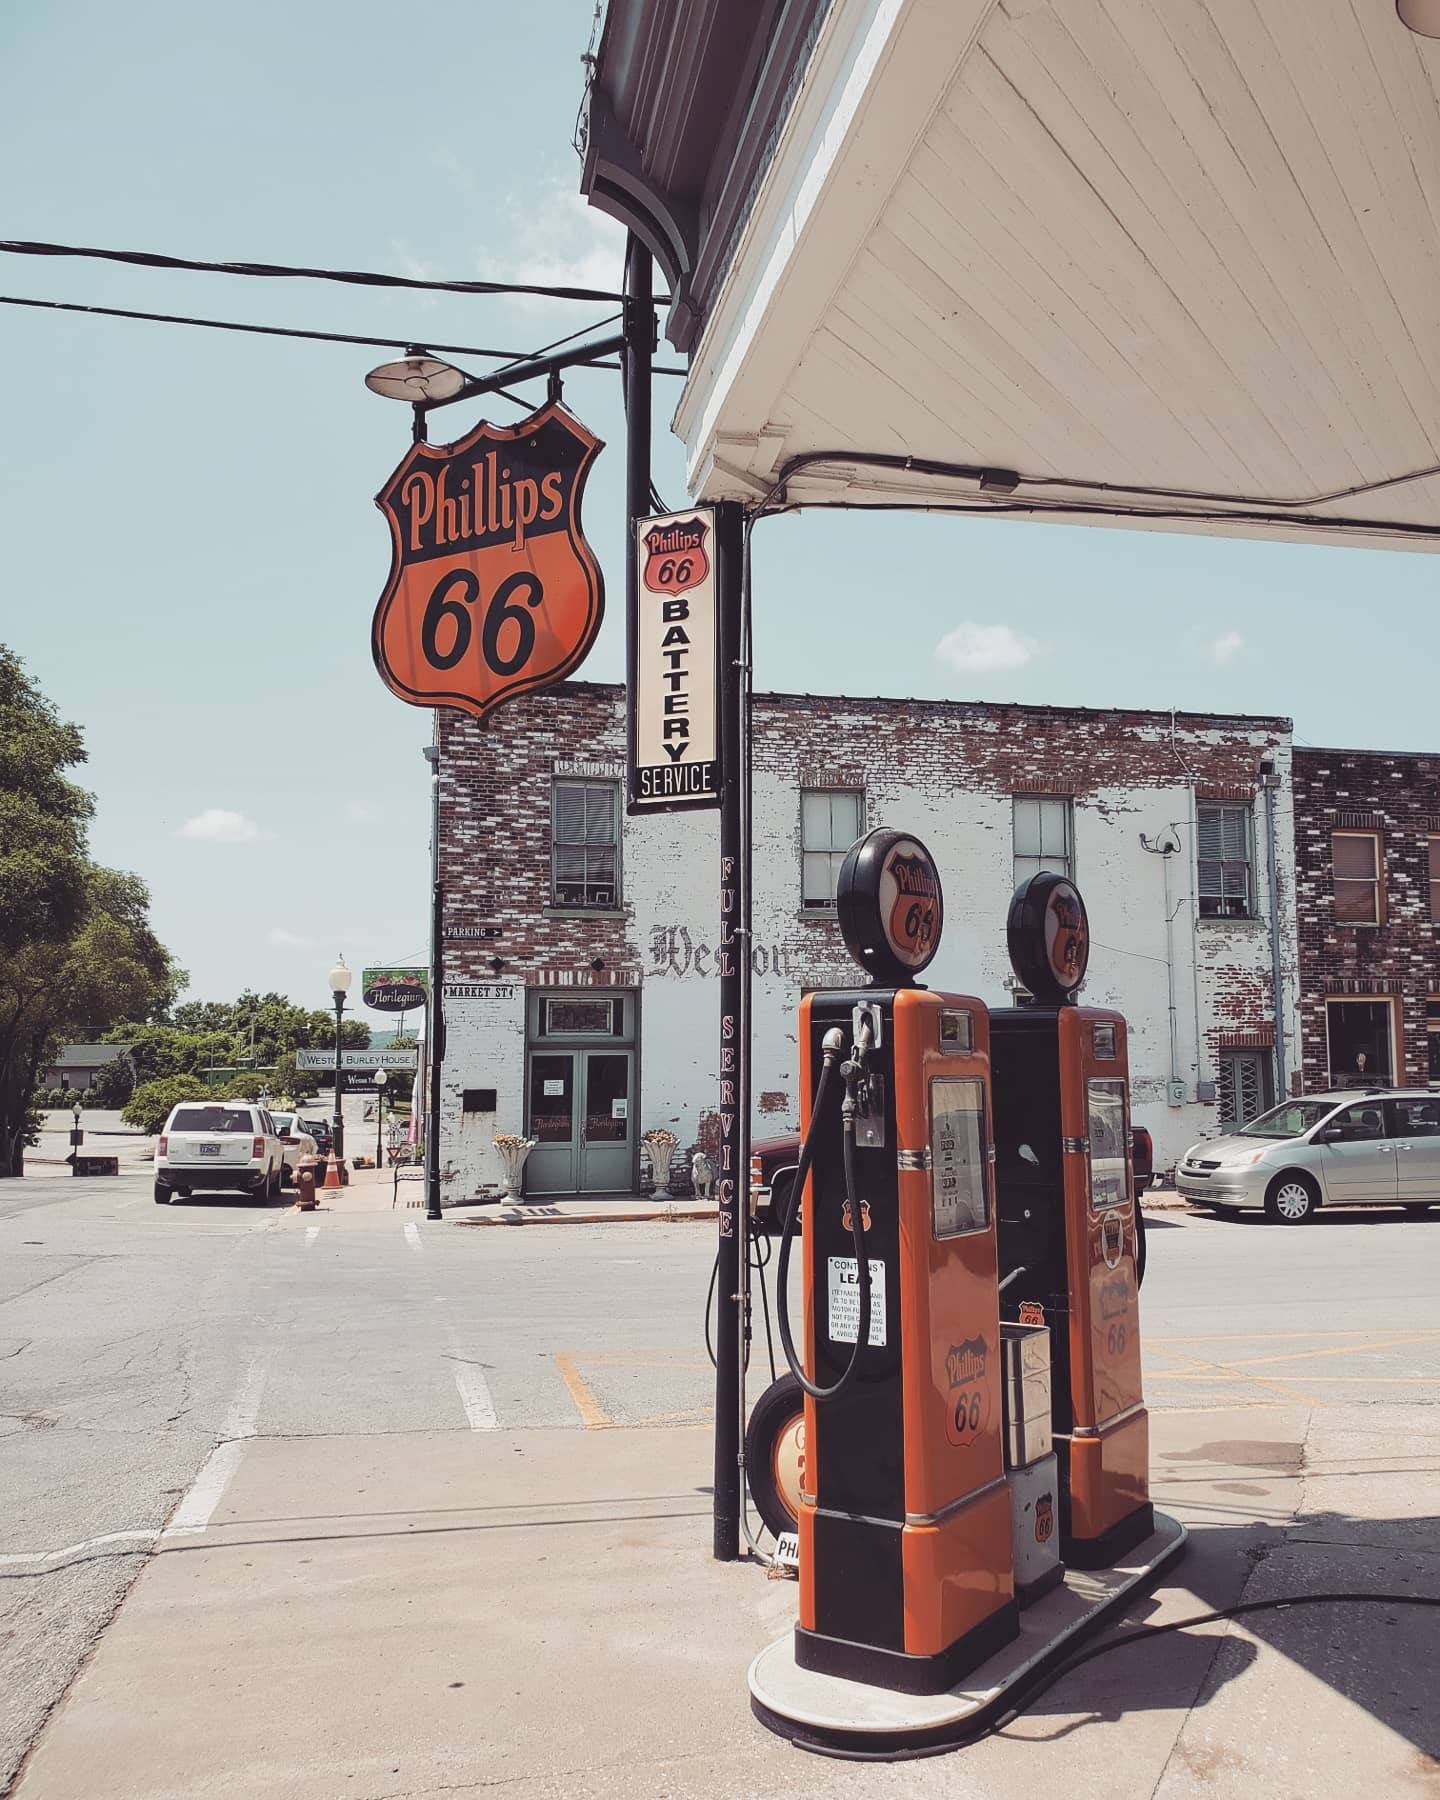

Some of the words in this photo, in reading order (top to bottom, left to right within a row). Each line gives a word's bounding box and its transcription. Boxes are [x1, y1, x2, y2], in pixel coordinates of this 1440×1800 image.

[401, 450, 564, 552] Phillips
[647, 529, 701, 554] Phillips
[658, 558, 694, 585] 66
[421, 568, 545, 677] 66
[661, 598, 691, 763] BATTERY
[640, 764, 712, 796] SERVICE
[447, 927, 487, 937] PARKING
[720, 856, 736, 977] FULL
[449, 986, 491, 998] MARKET
[495, 986, 508, 998] ST
[346, 1055, 380, 1065] BURLEY
[381, 1055, 411, 1065] HOUSE
[719, 1014, 736, 1238] SERVICE
[834, 1260, 878, 1273] CONTNS
[947, 1348, 985, 1385] Phillips
[954, 1391, 981, 1432] 66
